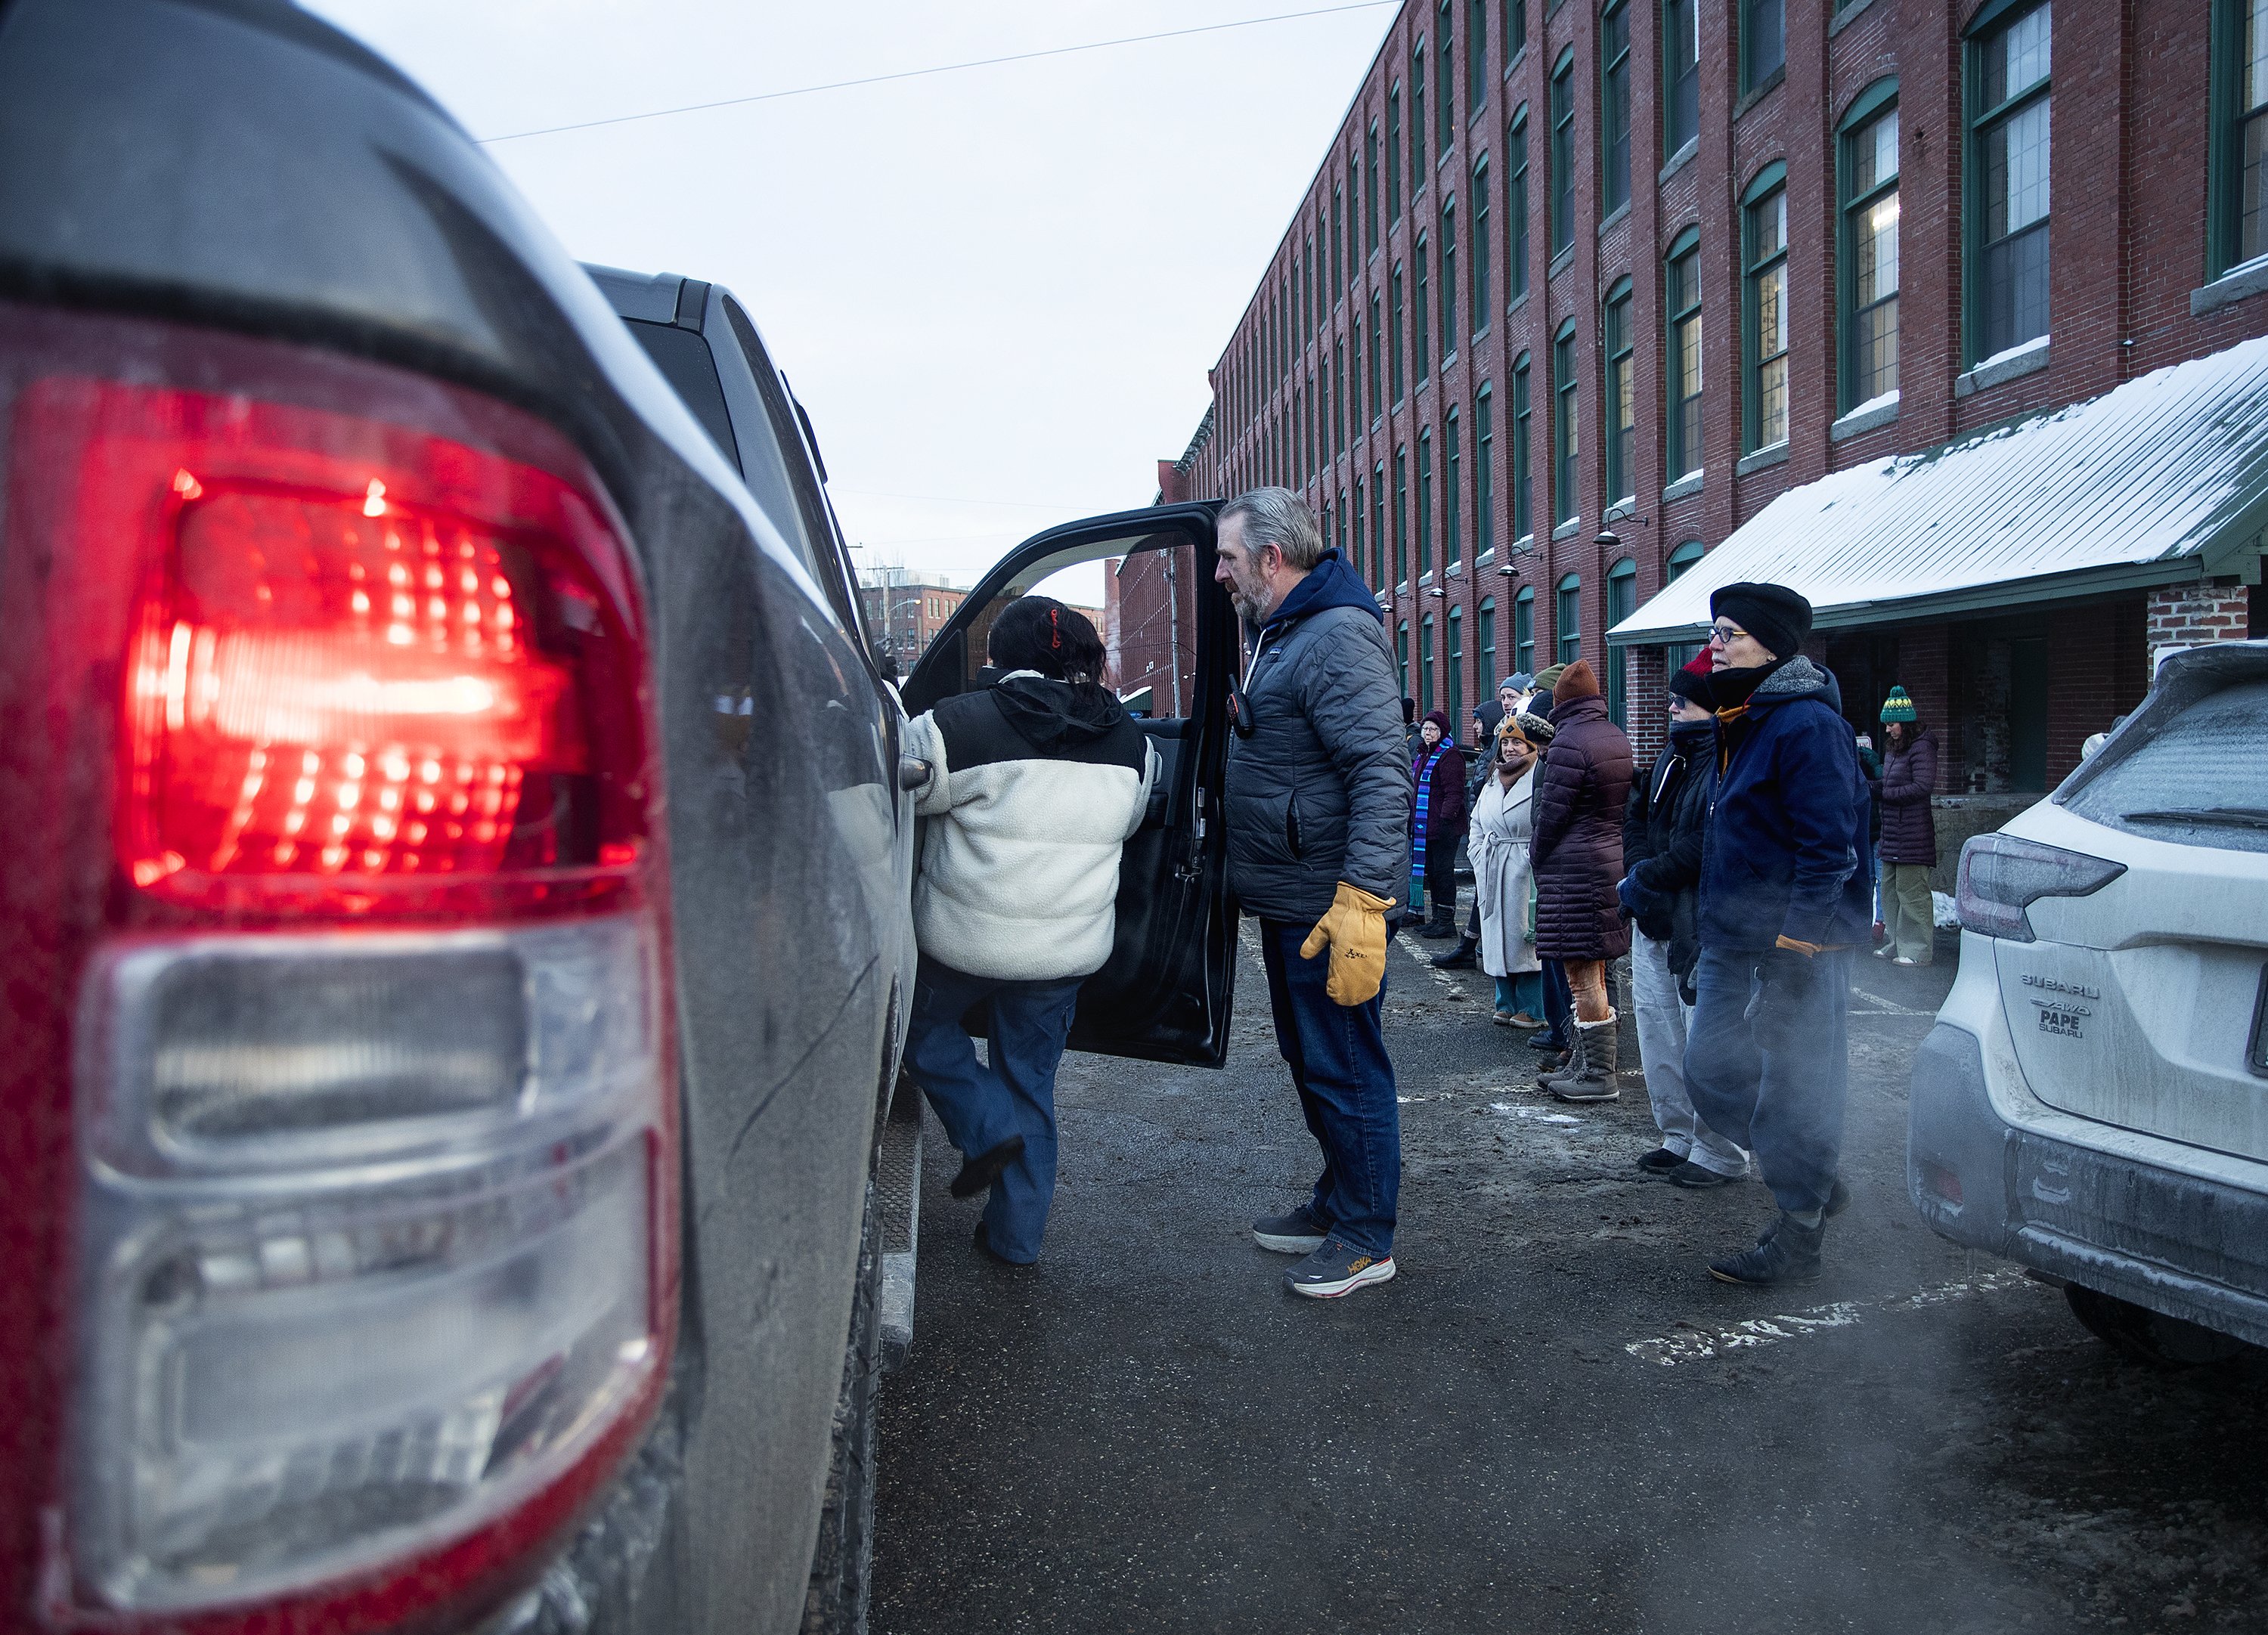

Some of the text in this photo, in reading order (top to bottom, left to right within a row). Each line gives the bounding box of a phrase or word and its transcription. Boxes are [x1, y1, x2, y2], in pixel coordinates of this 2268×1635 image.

[2021, 974, 2101, 1000] SUBARU
[2040, 1009, 2080, 1030] PAPE
[2039, 1023, 2083, 1039] SUBARU
[1347, 1256, 1372, 1276] HOKA
